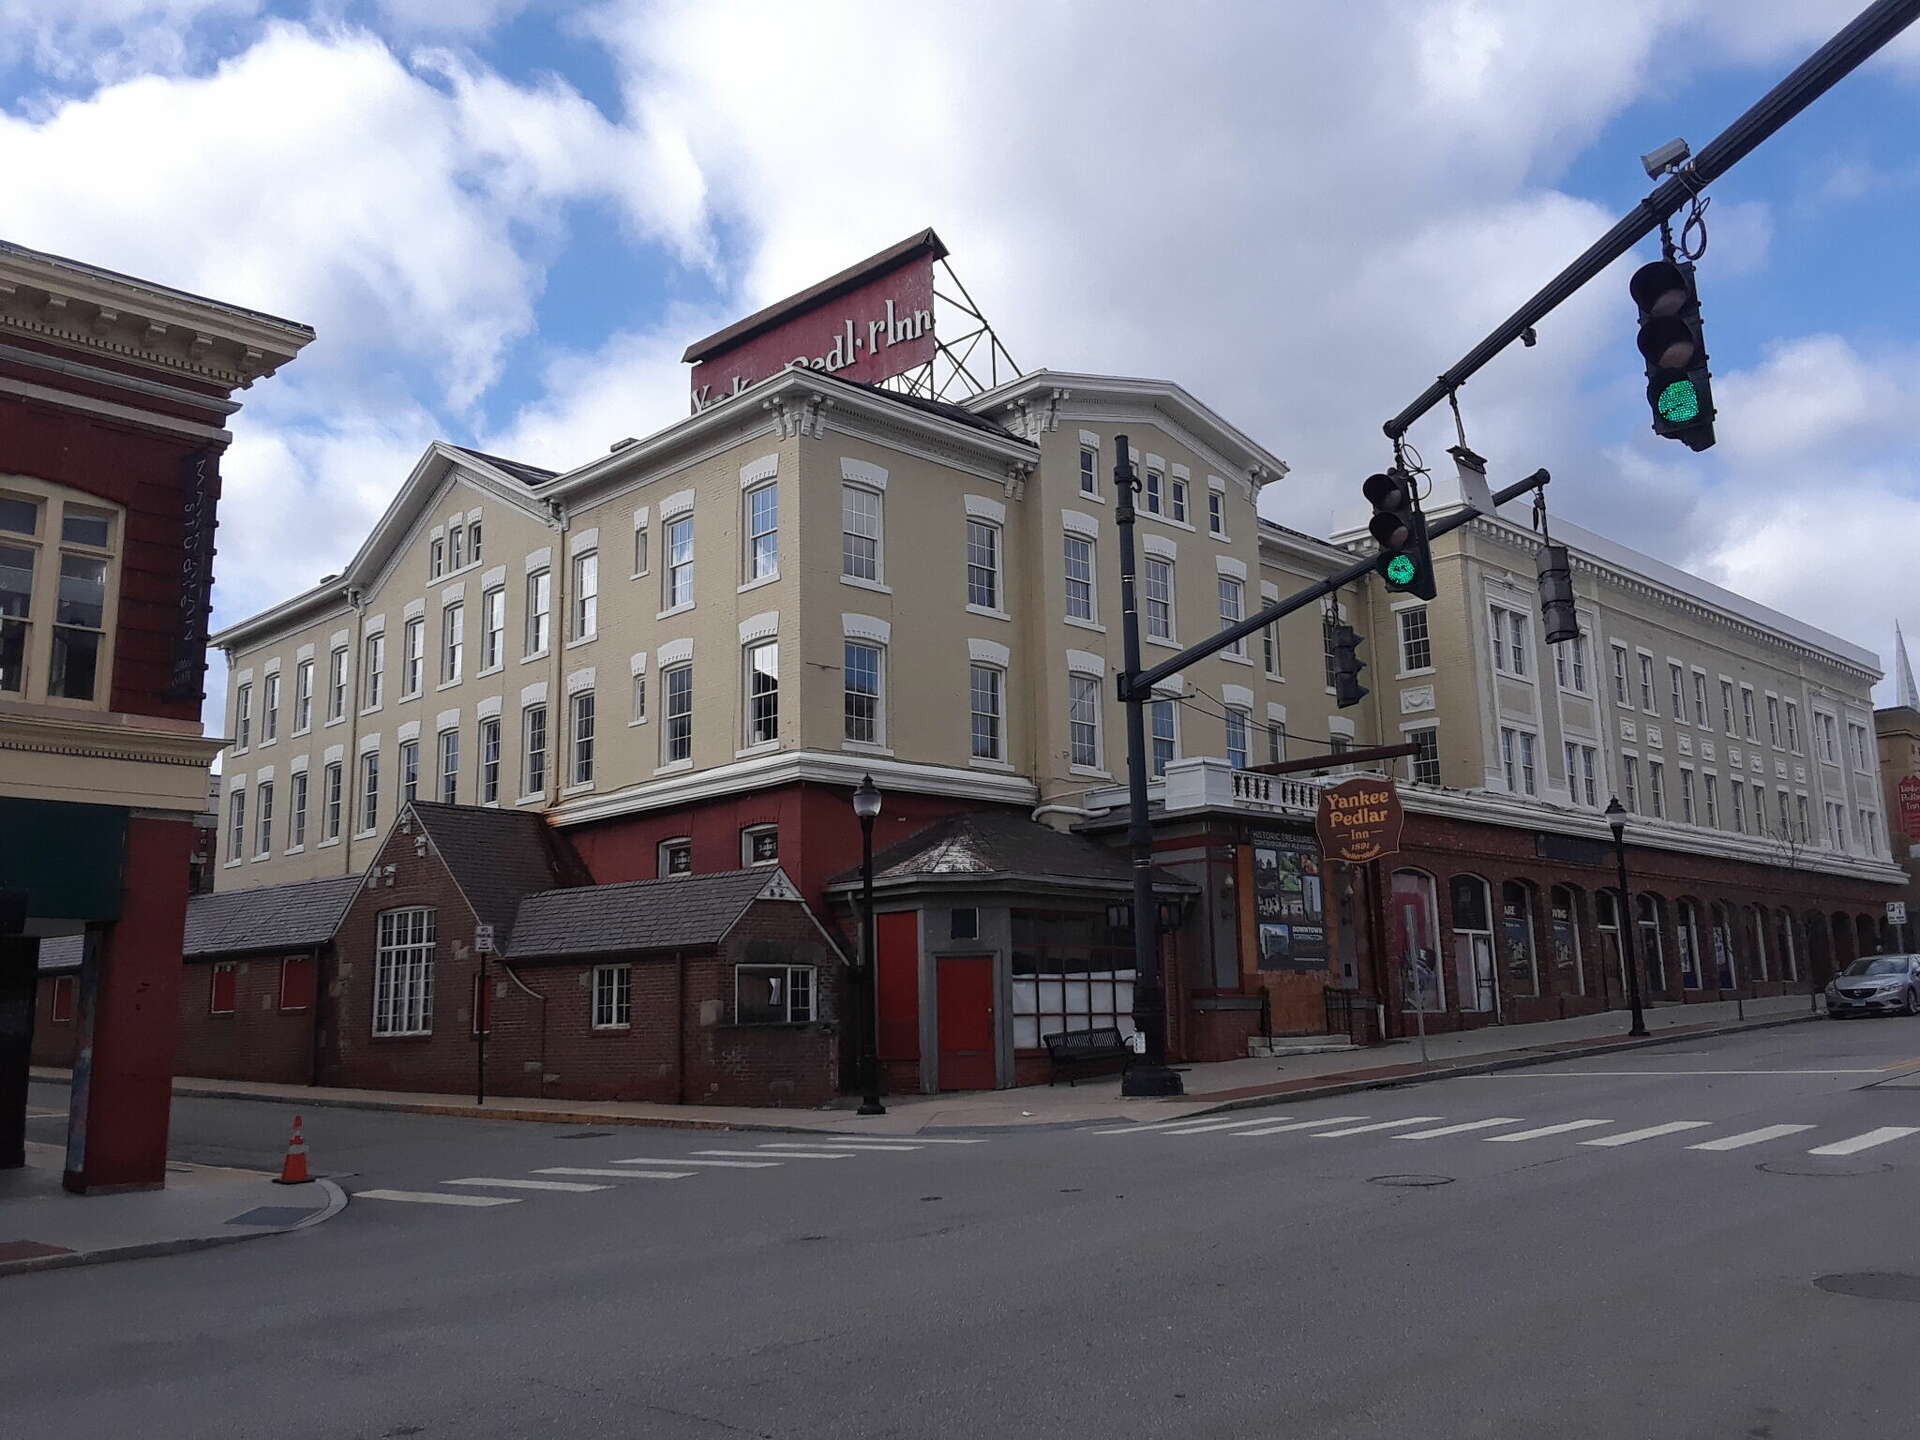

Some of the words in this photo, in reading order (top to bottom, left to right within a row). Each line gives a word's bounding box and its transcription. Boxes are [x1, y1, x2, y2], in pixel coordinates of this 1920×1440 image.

[885, 299, 931, 347] Inn
[1325, 790, 1389, 810] Yankee
[1329, 808, 1388, 827] Pedlar
[1351, 829, 1369, 840] Inn
